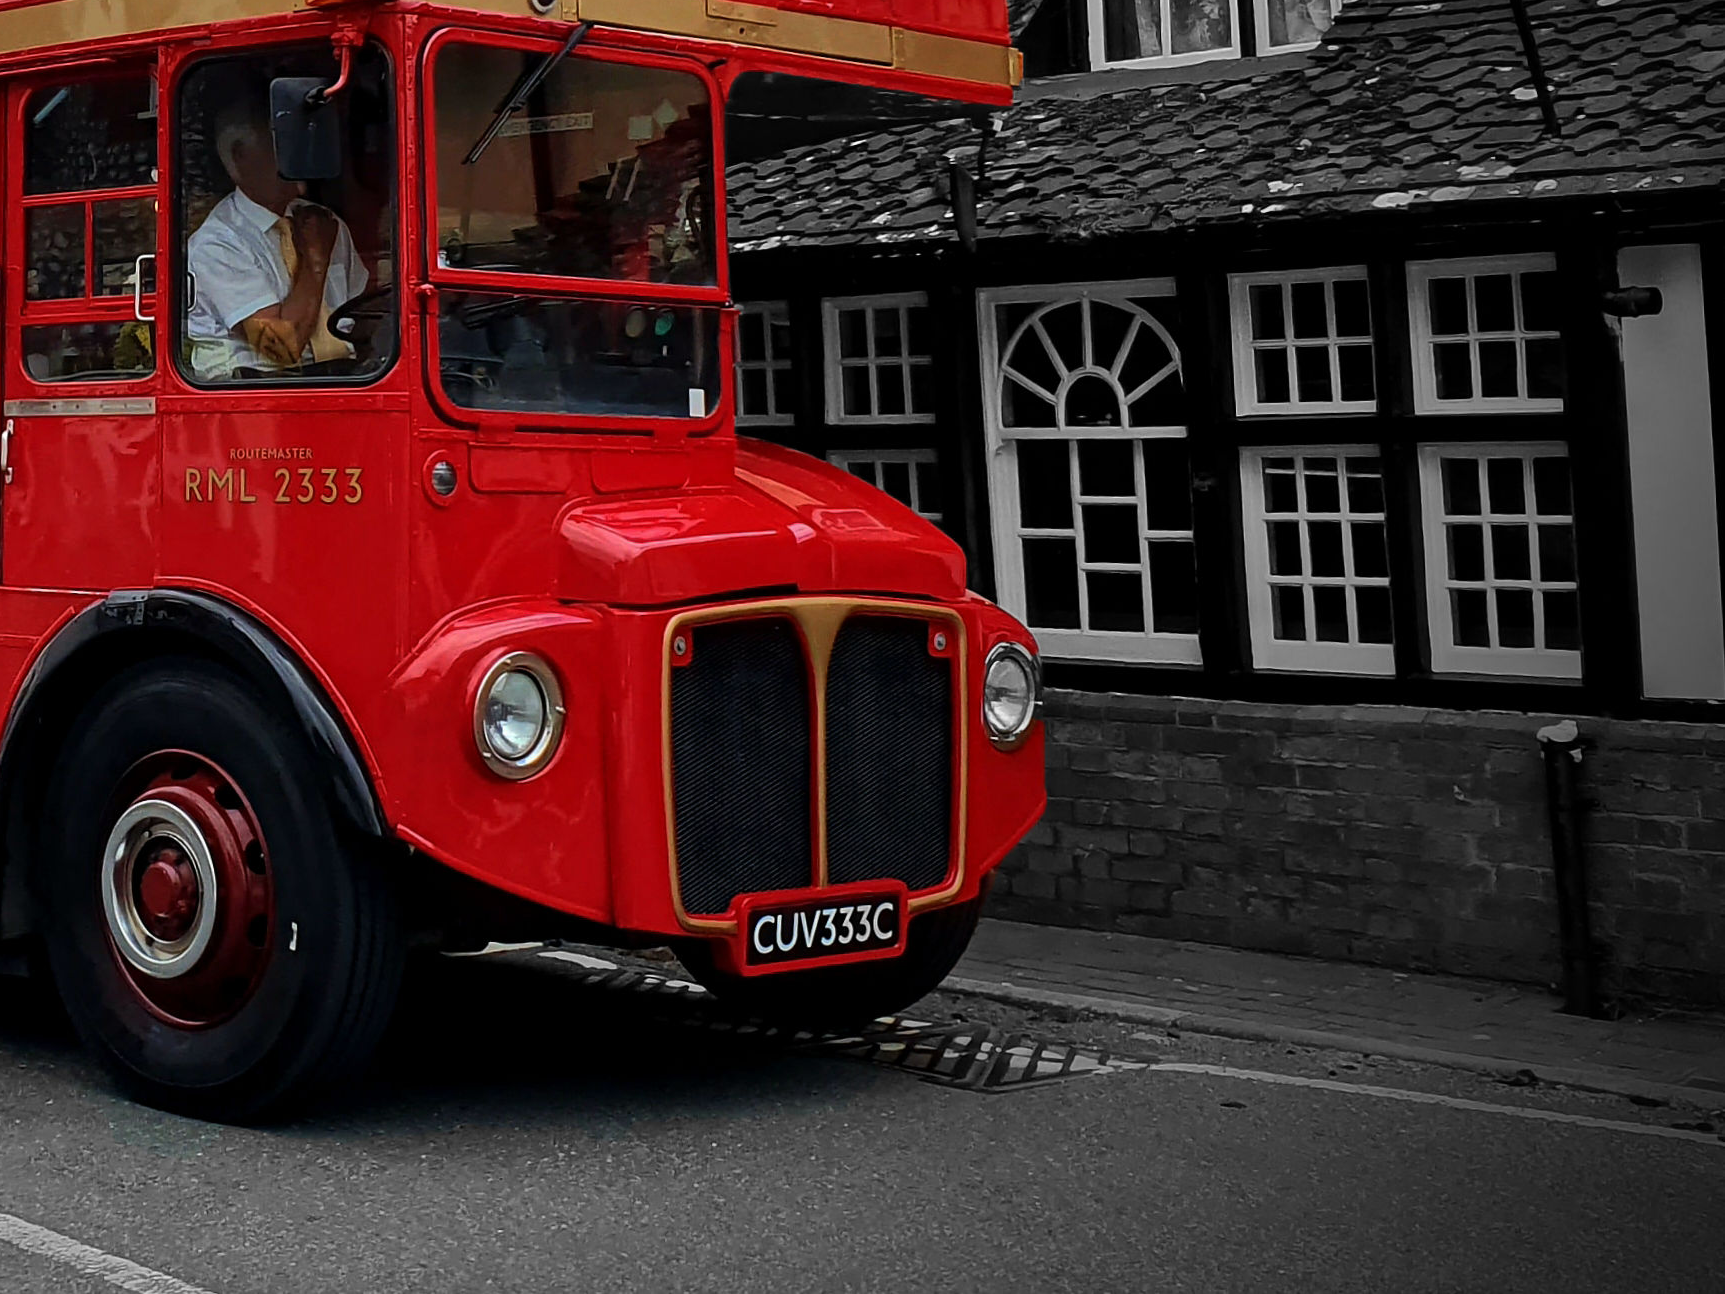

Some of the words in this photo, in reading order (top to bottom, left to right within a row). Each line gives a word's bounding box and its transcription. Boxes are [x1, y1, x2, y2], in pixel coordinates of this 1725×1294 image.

[229, 448, 313, 460] ROUTEMASTER
[184, 467, 257, 503] RML
[274, 467, 364, 504] 2333
[753, 902, 894, 955] CUV333C
